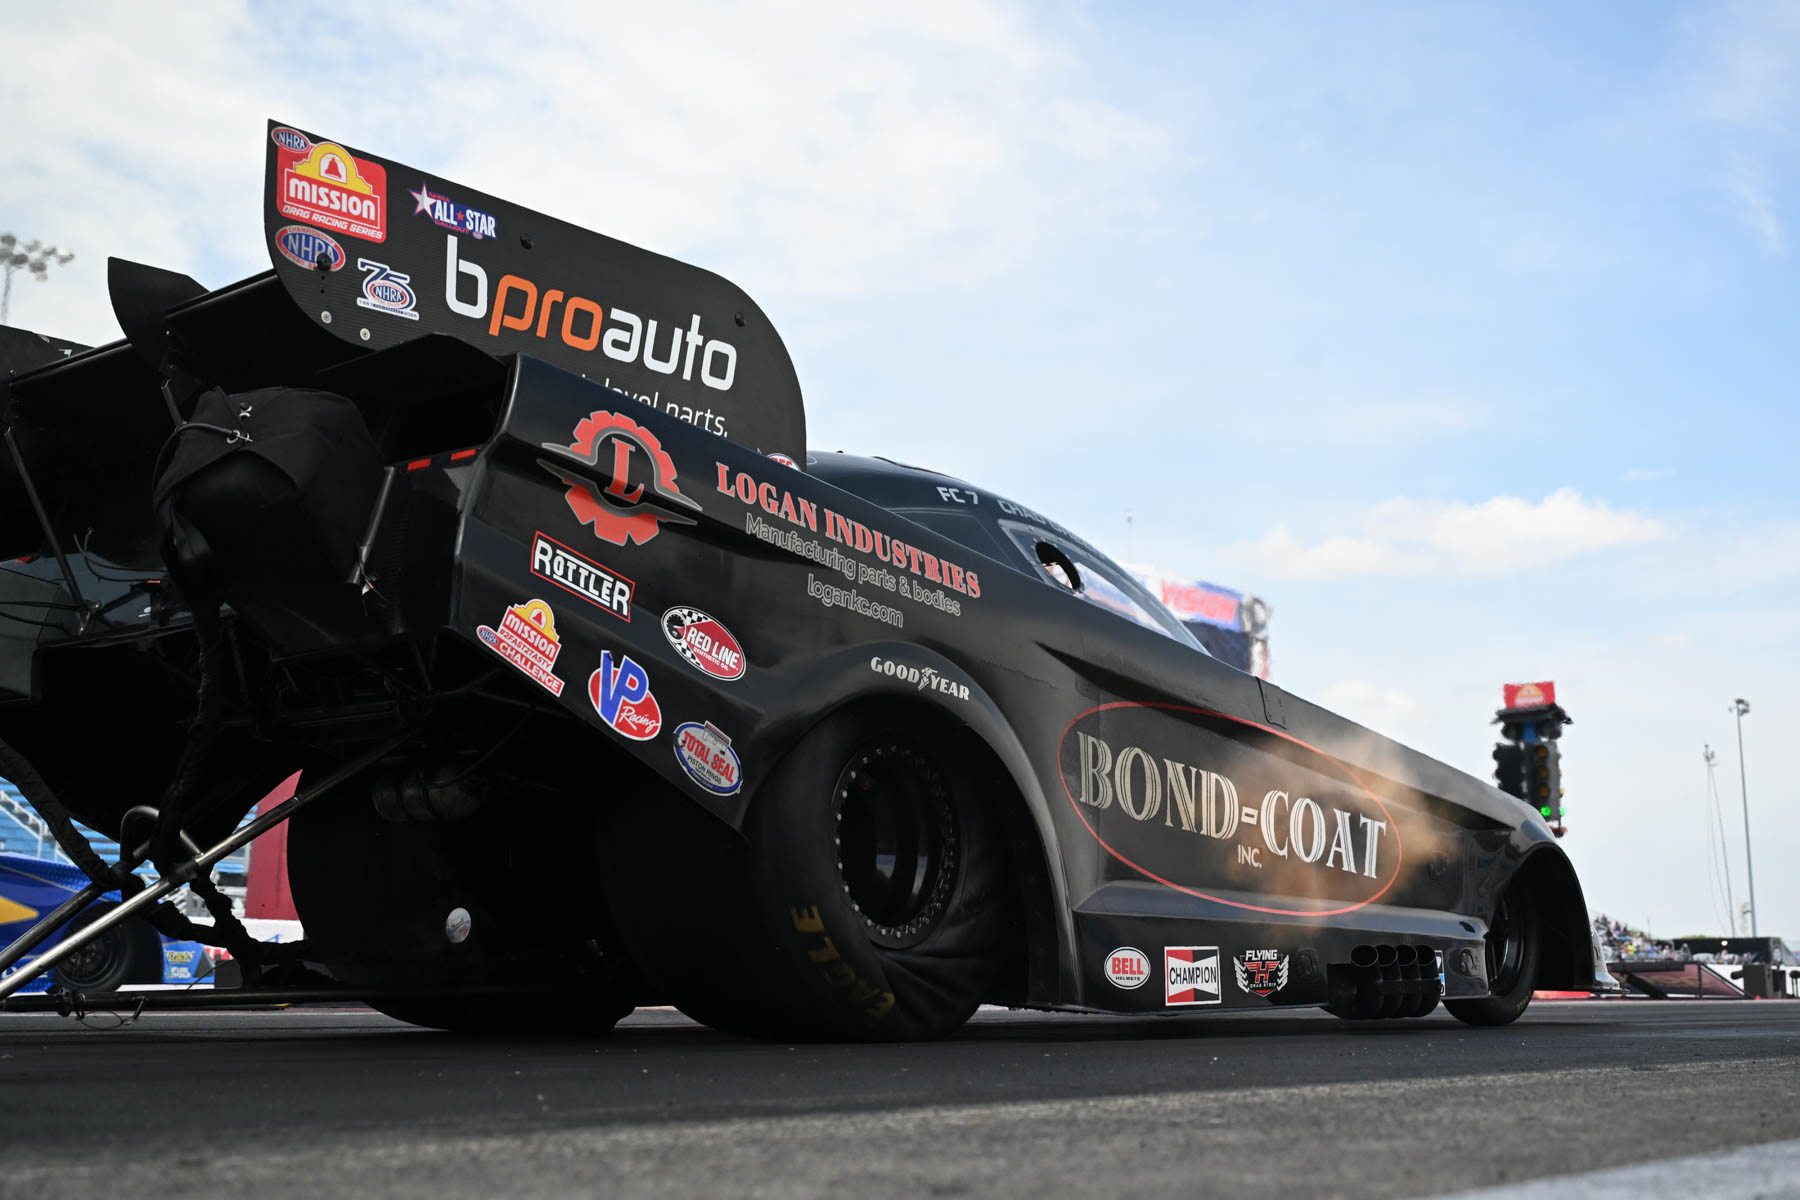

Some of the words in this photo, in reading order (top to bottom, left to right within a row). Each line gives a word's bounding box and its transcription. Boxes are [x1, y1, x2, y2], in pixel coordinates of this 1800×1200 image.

[278, 131, 306, 150] NHRA
[282, 204, 311, 219] DRAG
[311, 212, 348, 230] RACING
[349, 224, 383, 240] SERIES
[434, 199, 458, 226] ALL
[465, 208, 496, 238] STAR
[375, 286, 403, 302] NHRA
[445, 234, 738, 392] bproauto
[936, 487, 966, 504] FC
[966, 490, 979, 505] 7
[716, 461, 817, 532] LOGAN
[824, 508, 981, 599] INDUSTRIES
[534, 538, 631, 616] ROTTLER
[745, 512, 856, 580] Manufacturing
[858, 562, 897, 593] parts
[899, 575, 913, 599] &
[912, 580, 962, 617] bodies
[807, 573, 905, 628] logankc.com
[500, 642, 561, 693] CHALLENGE
[686, 626, 712, 653] RED
[711, 641, 741, 669] LINE
[600, 650, 649, 727] VP
[618, 706, 661, 734] Racing
[682, 730, 711, 766] TOTAL
[711, 754, 735, 784] SEAL
[1076, 731, 1387, 880] BOND-COAT
[1237, 843, 1263, 869] INC.
[1111, 956, 1144, 975] BELL
[1169, 966, 1217, 985] CHAMPION
[1245, 949, 1278, 961] FLYING
